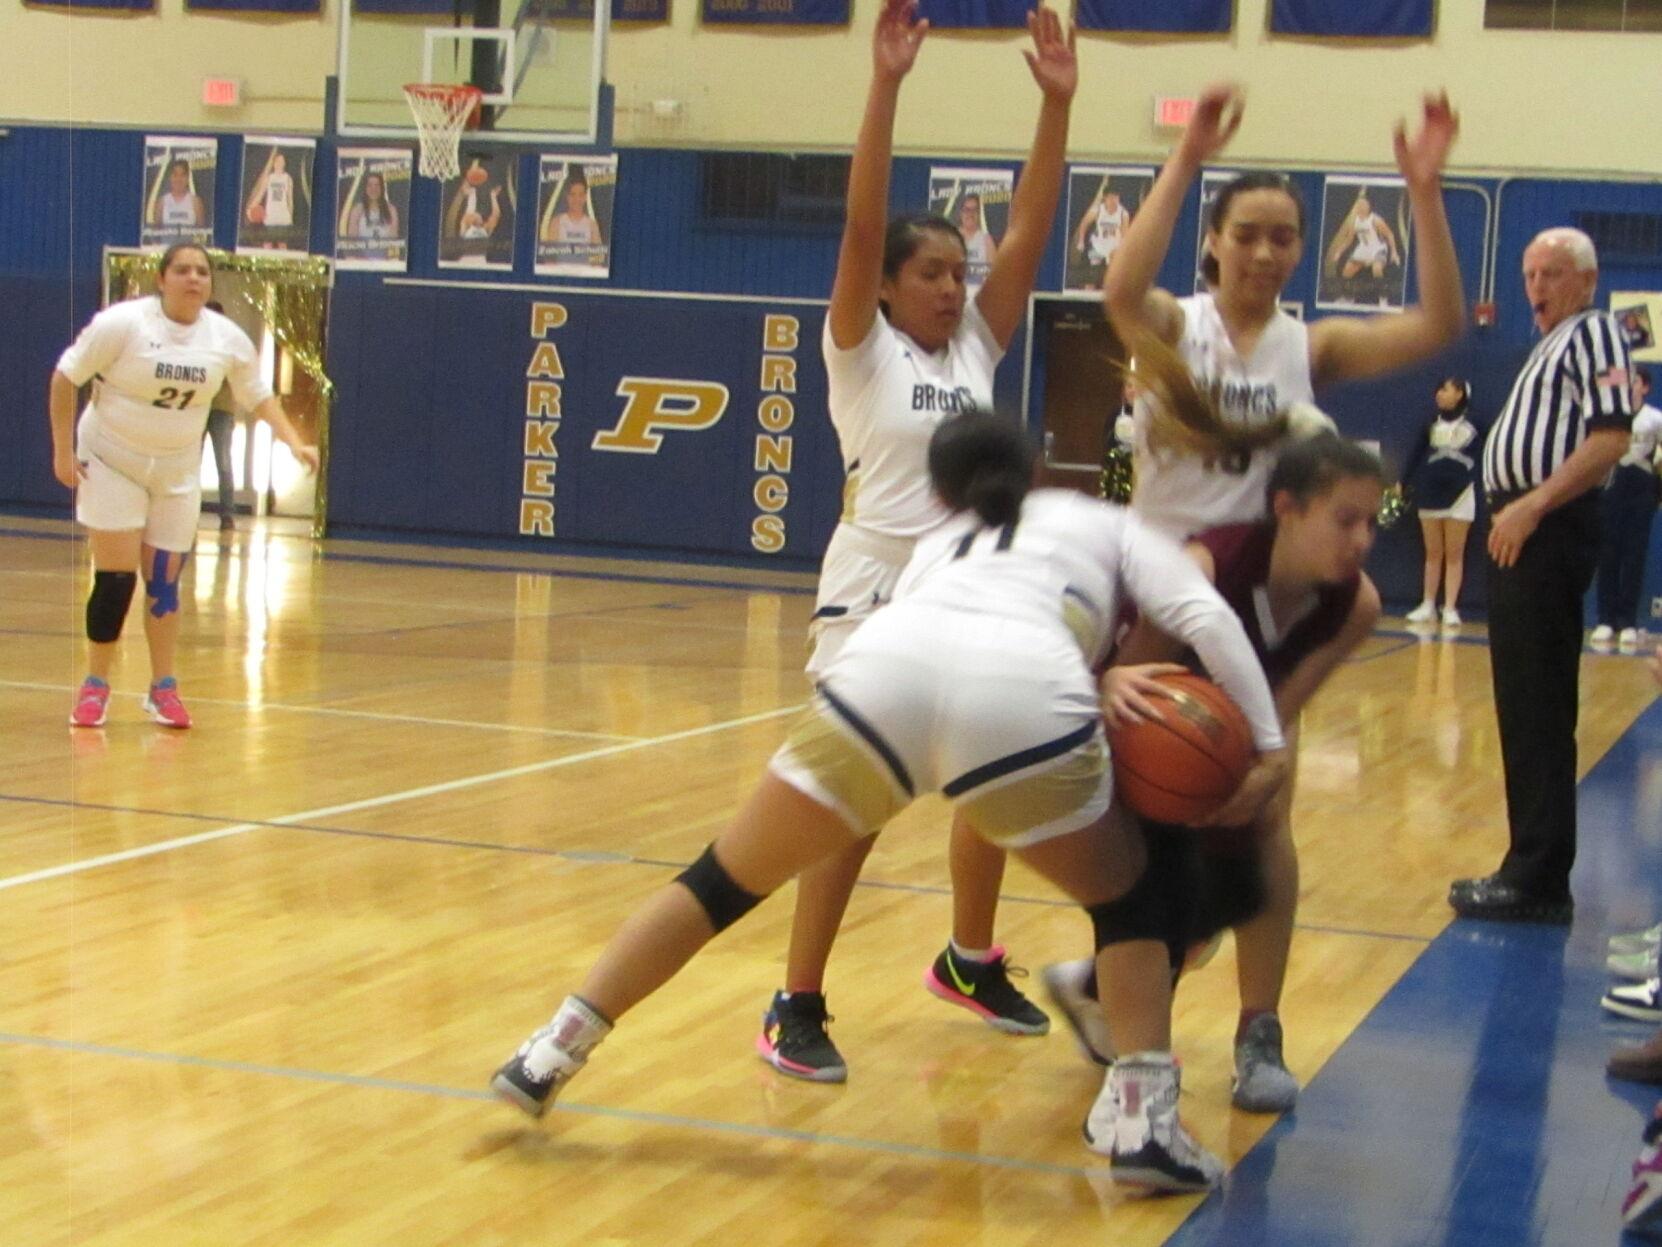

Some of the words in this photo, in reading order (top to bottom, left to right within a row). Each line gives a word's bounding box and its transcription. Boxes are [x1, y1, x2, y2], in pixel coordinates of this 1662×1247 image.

[152, 386, 197, 411] 21
[155, 361, 207, 384] BRONCS
[519, 301, 568, 537] PARKER
[590, 375, 730, 455] P
[751, 313, 800, 554] BRONCS
